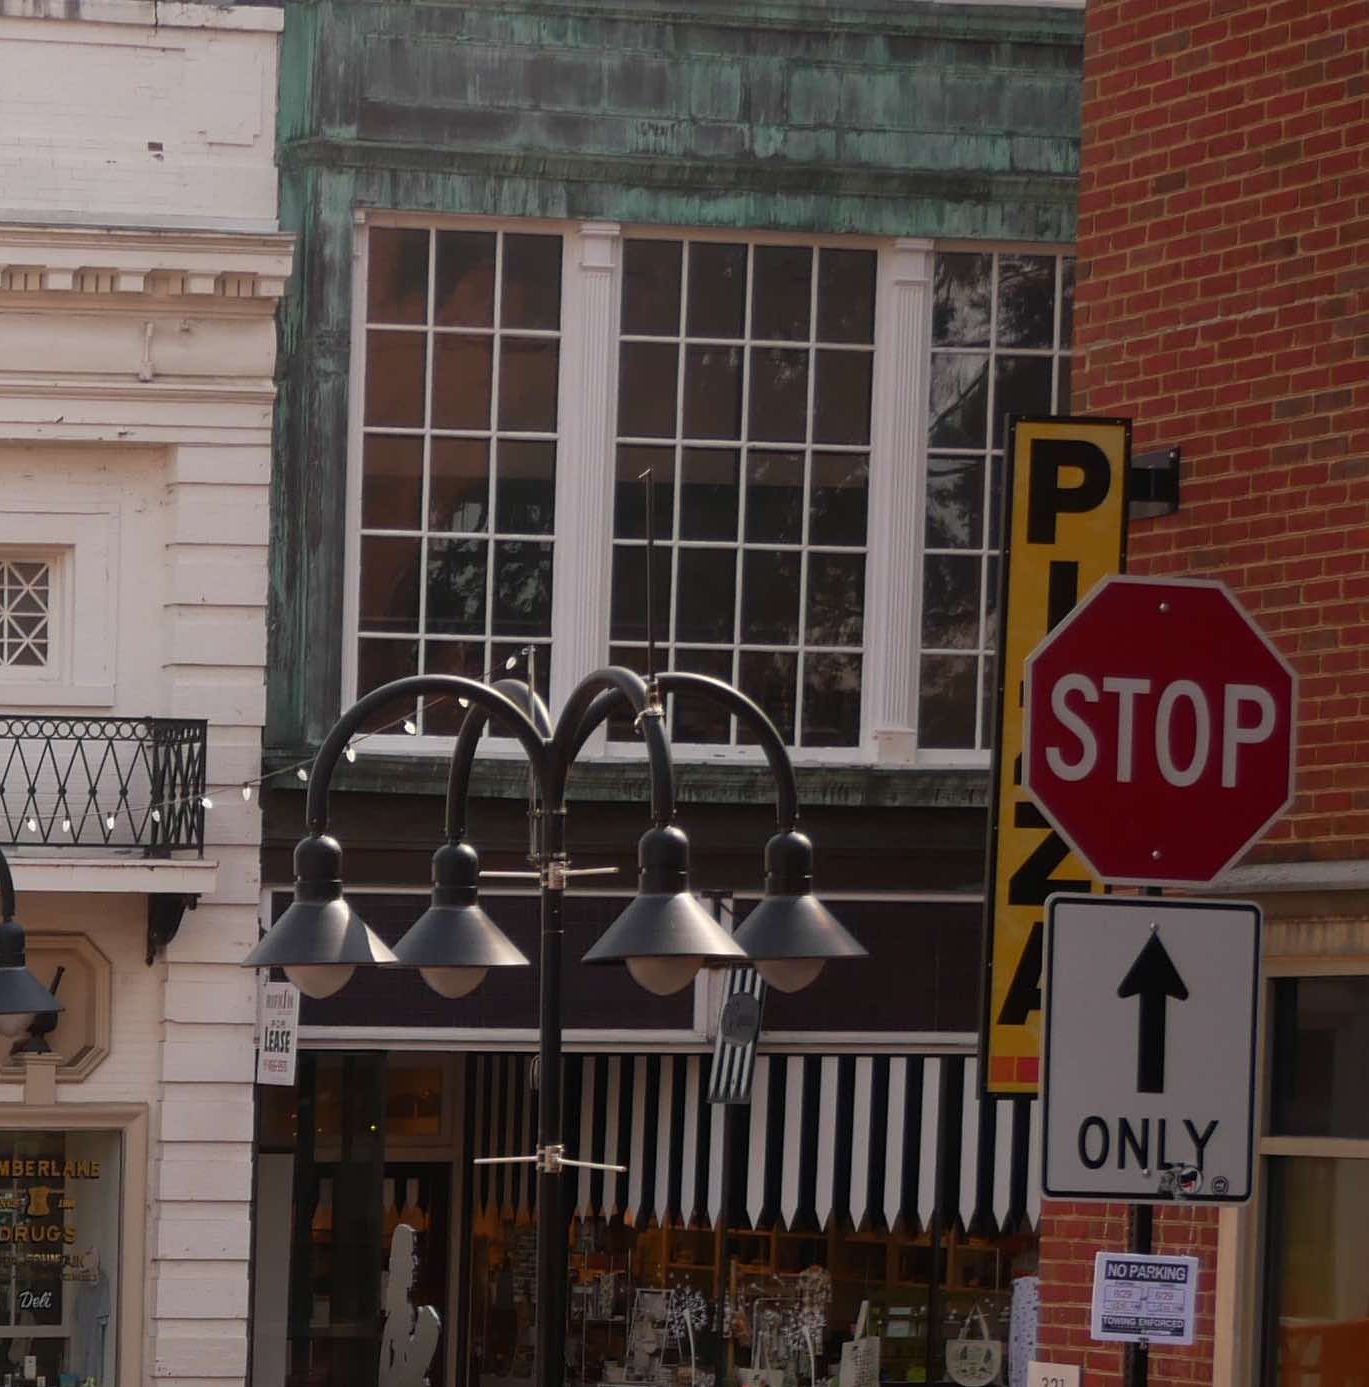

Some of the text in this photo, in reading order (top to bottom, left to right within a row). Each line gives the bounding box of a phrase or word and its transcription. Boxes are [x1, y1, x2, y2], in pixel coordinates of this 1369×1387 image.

[1045, 674, 1277, 789] STOP
[264, 1026, 291, 1053] LEASE
[1077, 1116, 1219, 1172] ONLY
[1107, 1263, 1186, 1281] NO PARKING
[19, 1291, 52, 1309] Deli
[1103, 1316, 1184, 1329] TOWING ENFORCED
